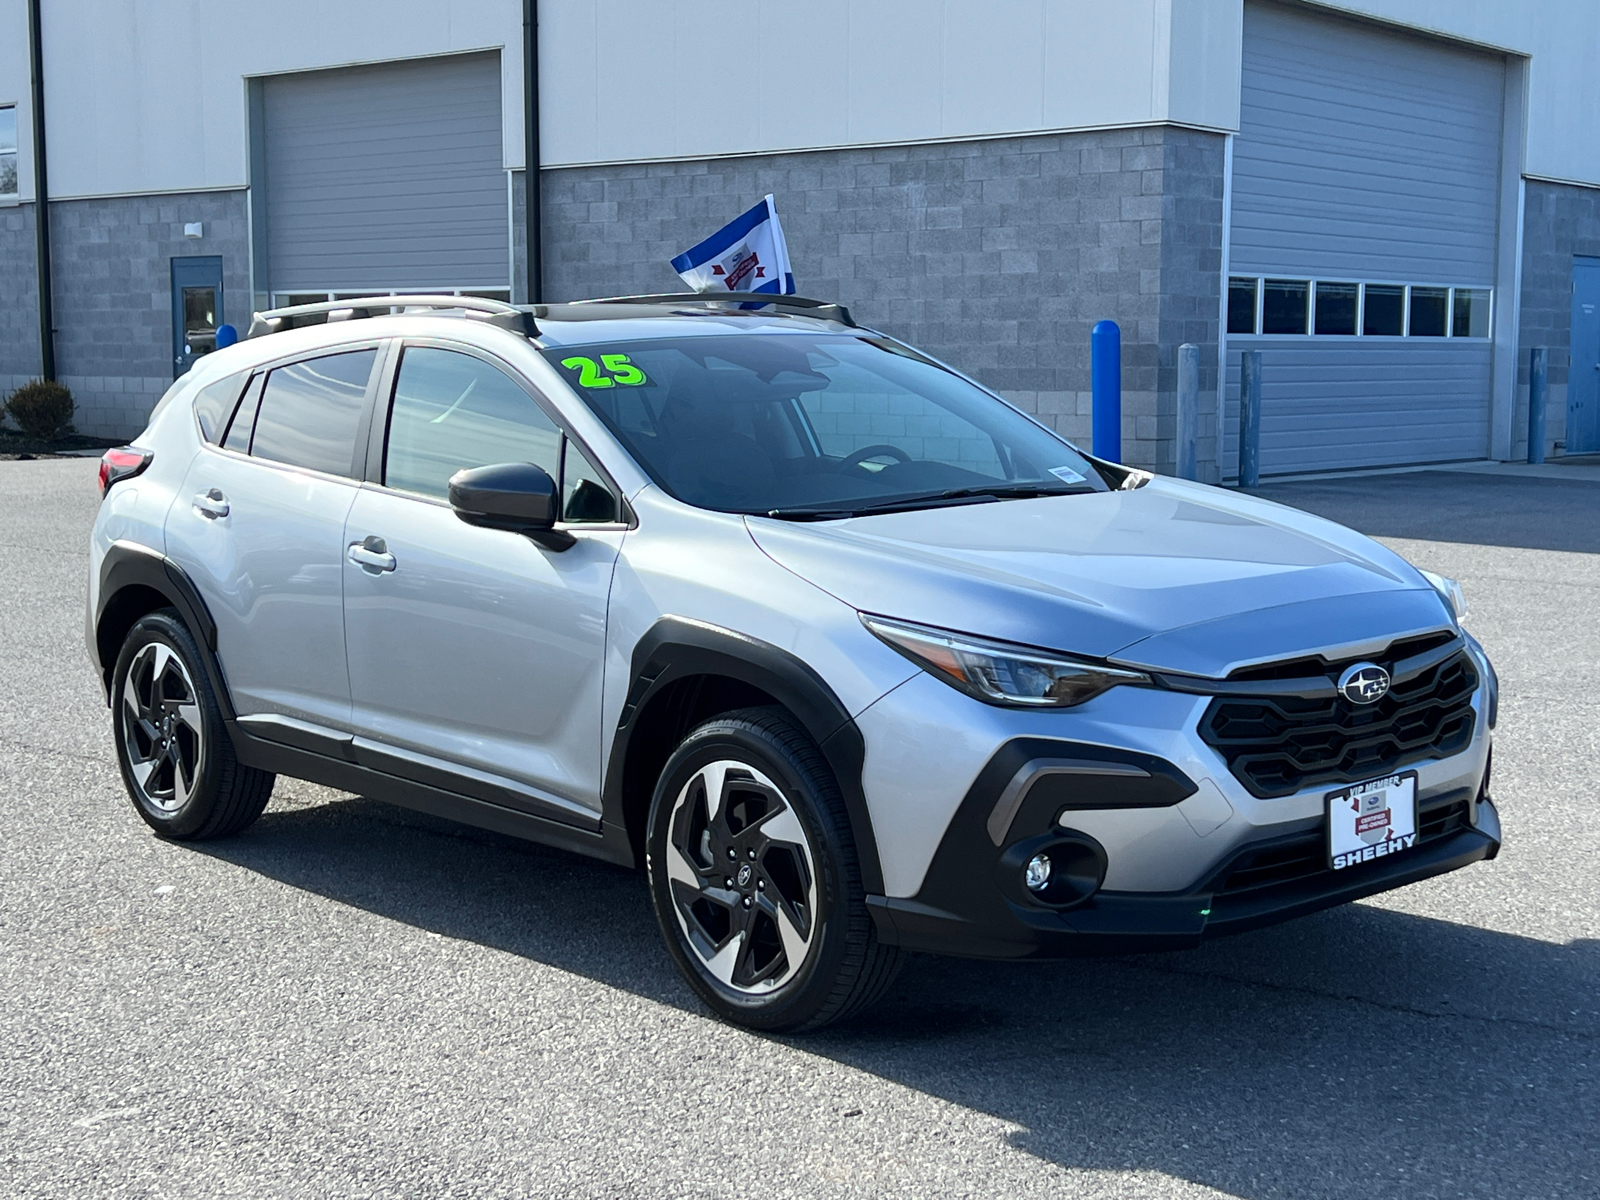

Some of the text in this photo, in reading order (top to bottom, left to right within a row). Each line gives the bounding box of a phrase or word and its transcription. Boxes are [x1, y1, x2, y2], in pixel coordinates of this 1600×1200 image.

[561, 354, 647, 389] 25
[1350, 776, 1400, 796] VIP MEMBER
[1333, 834, 1416, 869] SHEEHY
